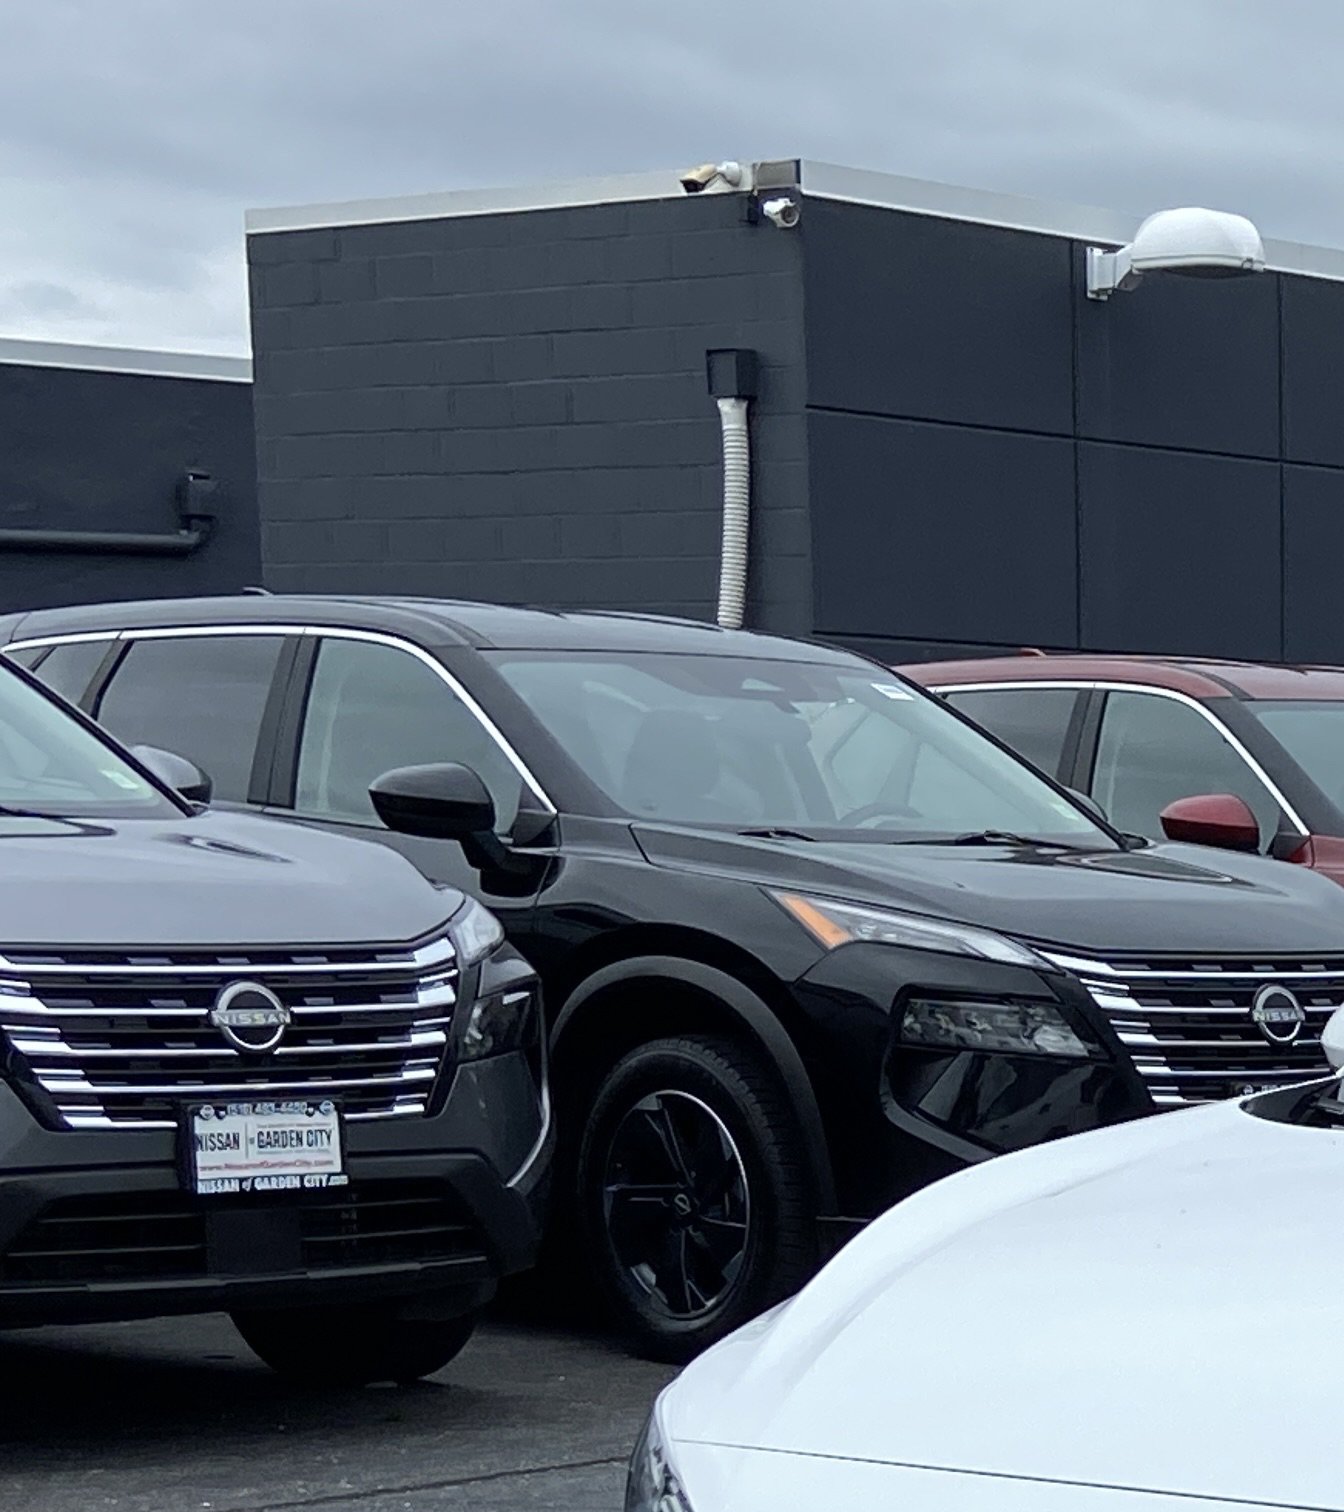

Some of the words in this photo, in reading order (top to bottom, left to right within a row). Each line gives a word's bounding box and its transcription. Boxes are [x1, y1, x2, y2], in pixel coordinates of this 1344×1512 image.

[212, 1010, 291, 1026] NISSAN
[198, 1132, 240, 1152] NISSAN
[257, 1129, 302, 1149] GARDEN
[306, 1128, 332, 1148] CITY
[198, 1179, 240, 1194] NISSAN
[254, 1175, 301, 1190] GARDEN
